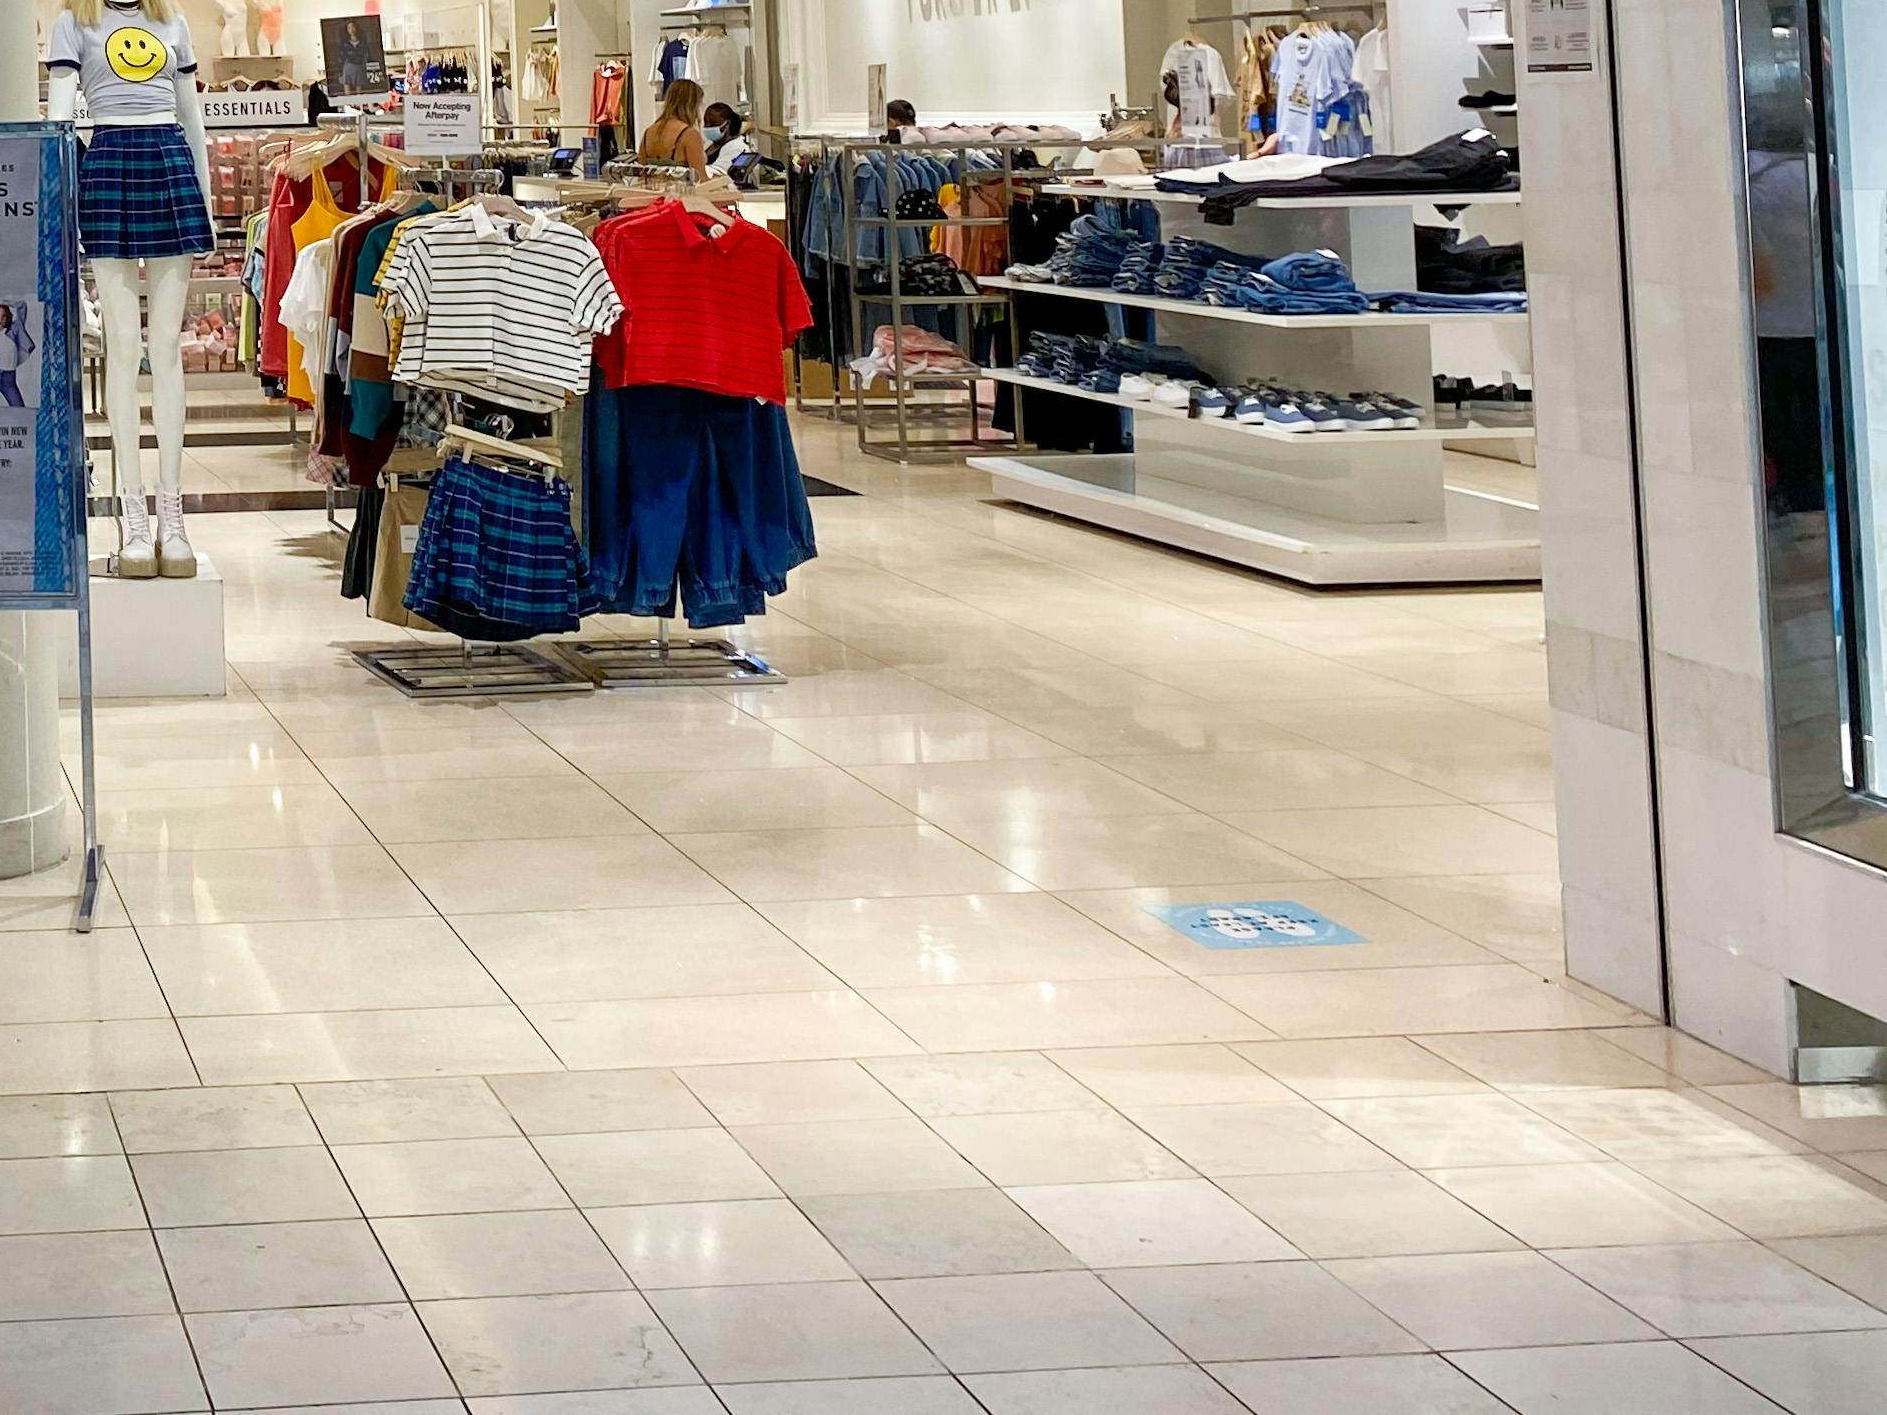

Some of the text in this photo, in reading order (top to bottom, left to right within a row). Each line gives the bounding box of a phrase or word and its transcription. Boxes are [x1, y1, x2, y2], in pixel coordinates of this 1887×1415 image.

[205, 101, 291, 116] ESSENTIALS
[433, 102, 471, 112] Accepting
[425, 111, 459, 120] Afterpay
[11, 426, 28, 436] NEW
